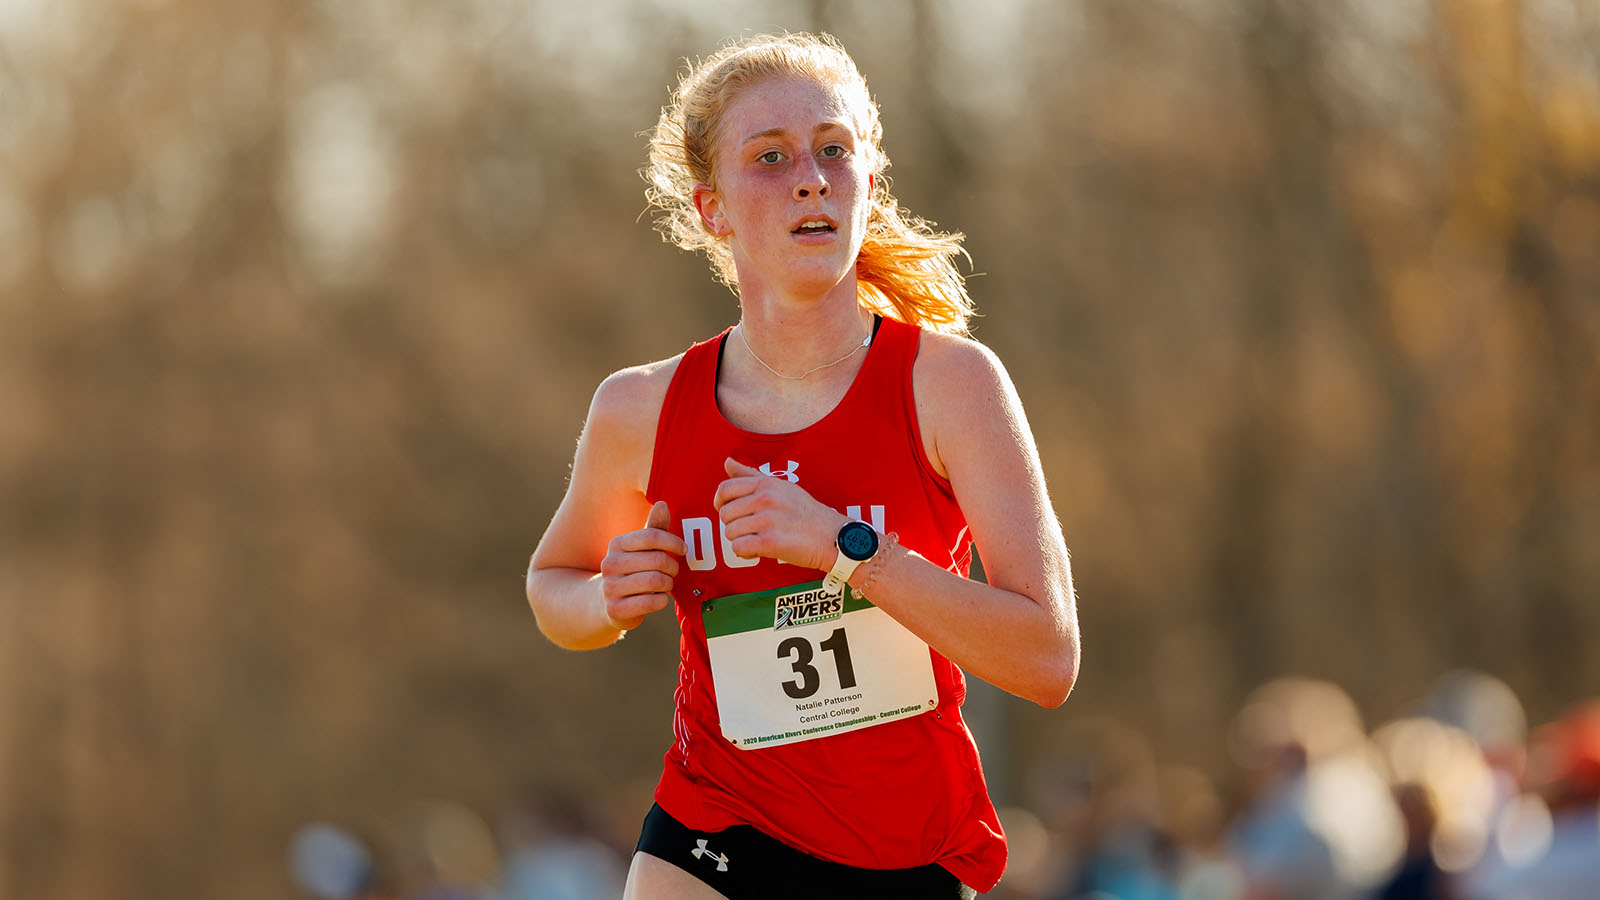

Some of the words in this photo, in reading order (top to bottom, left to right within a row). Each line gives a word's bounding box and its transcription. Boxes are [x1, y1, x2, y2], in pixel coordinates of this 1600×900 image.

[777, 587, 842, 608] AMERIC
[776, 598, 842, 629] RIVERS
[776, 627, 857, 699] 31
[795, 700, 823, 712] Natalie
[823, 692, 863, 706] Patterson
[799, 712, 828, 724] Central
[829, 705, 861, 718] College
[743, 737, 758, 745] 2020
[758, 733, 785, 743] American
[784, 730, 802, 739] Rivers
[802, 724, 835, 735] Conference
[834, 714, 877, 729] Championships
[879, 708, 901, 719] Central
[900, 704, 922, 714] College
